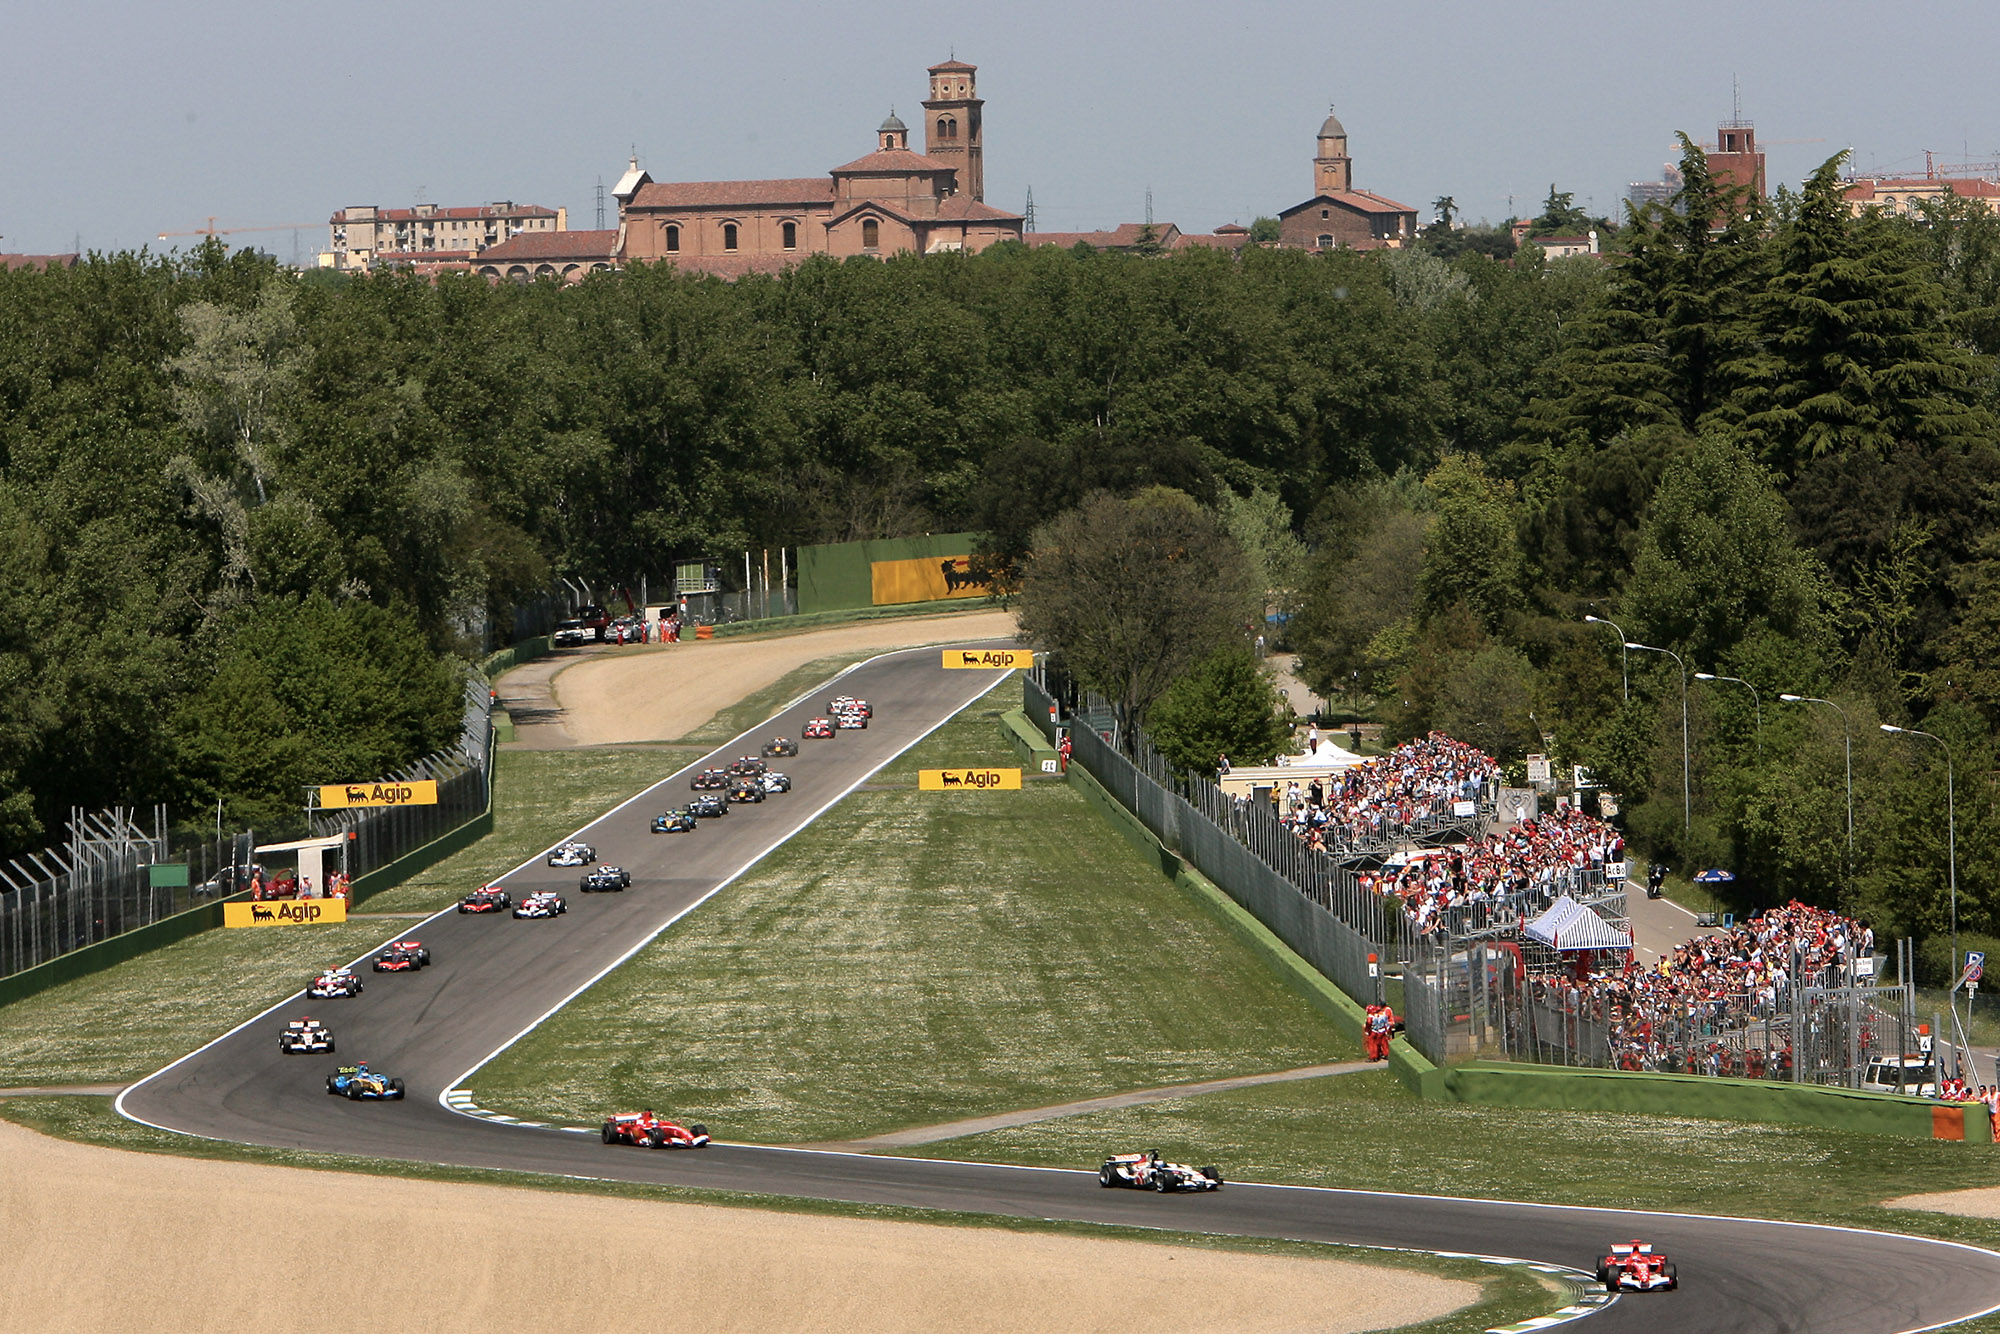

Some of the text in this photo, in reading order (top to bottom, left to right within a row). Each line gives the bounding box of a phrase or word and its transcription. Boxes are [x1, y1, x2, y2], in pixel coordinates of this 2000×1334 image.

[982, 651, 1014, 667] Agip
[964, 771, 1001, 788] Agip
[371, 783, 412, 804] Agip
[278, 902, 321, 922] Agip
